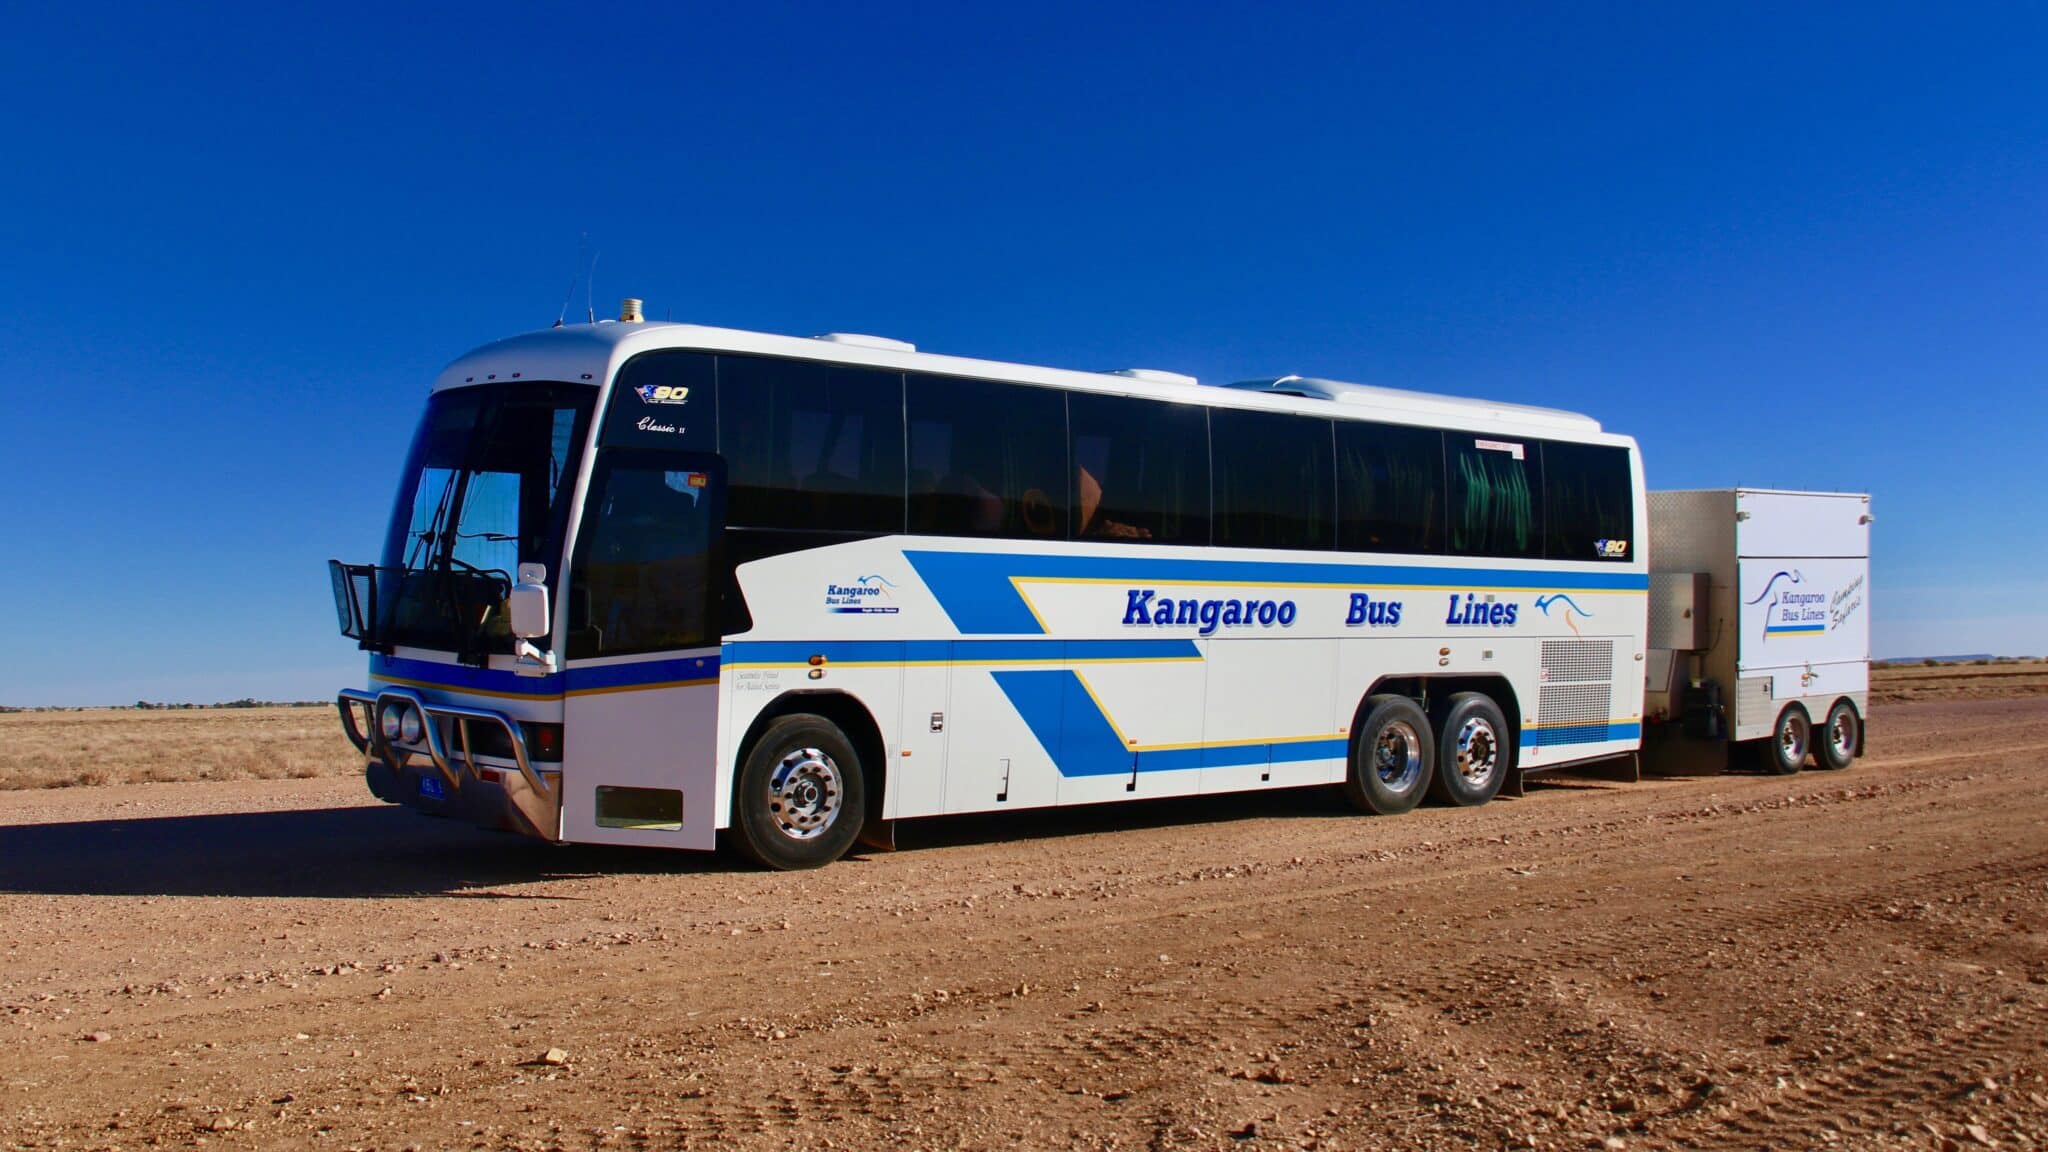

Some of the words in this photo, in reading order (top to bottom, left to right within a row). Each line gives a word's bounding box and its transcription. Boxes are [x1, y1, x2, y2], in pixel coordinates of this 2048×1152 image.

[637, 416, 675, 433] Classic
[827, 584, 880, 598] Kangaroo
[826, 597, 840, 605] Bus
[842, 597, 861, 605] Lines
[1782, 591, 1825, 607] Kangaroo
[1122, 589, 1297, 636] Kangaroo
[1345, 592, 1402, 627] Bus
[1446, 592, 1519, 626] Lines
[1782, 608, 1799, 622] Bus
[1801, 607, 1825, 621] Lines
